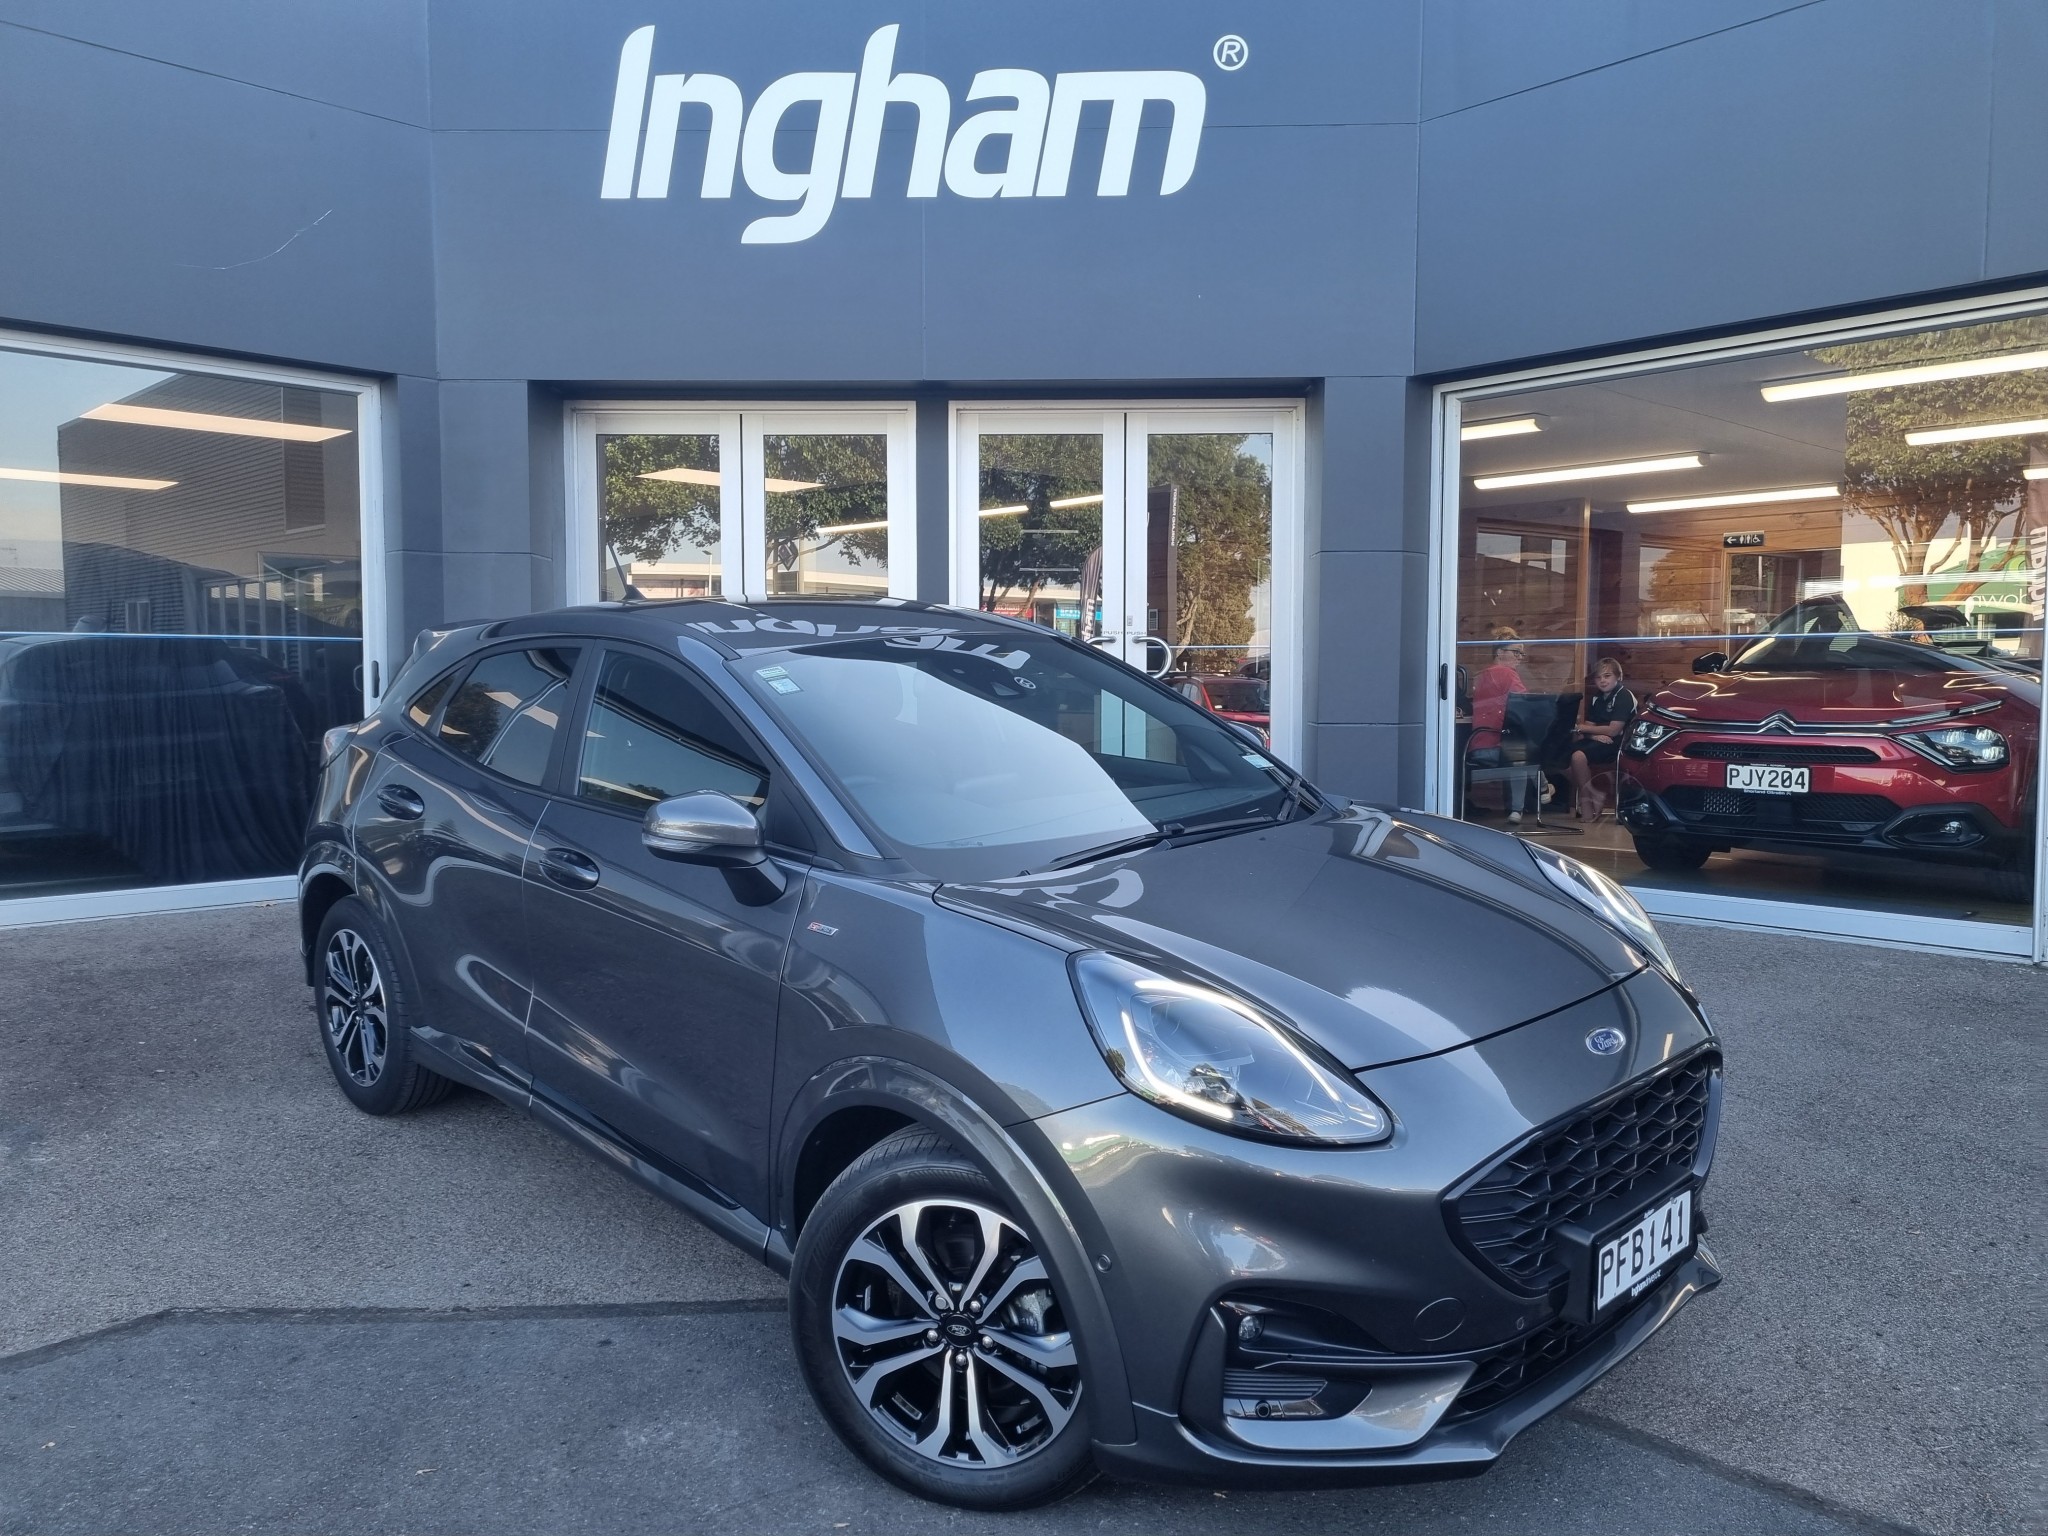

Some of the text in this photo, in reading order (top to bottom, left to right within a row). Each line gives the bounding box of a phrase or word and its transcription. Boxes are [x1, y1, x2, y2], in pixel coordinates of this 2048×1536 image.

[600, 24, 1206, 244] Ingham
[1728, 767, 1806, 790] PJY204
[1600, 1200, 1683, 1300] PFB141
